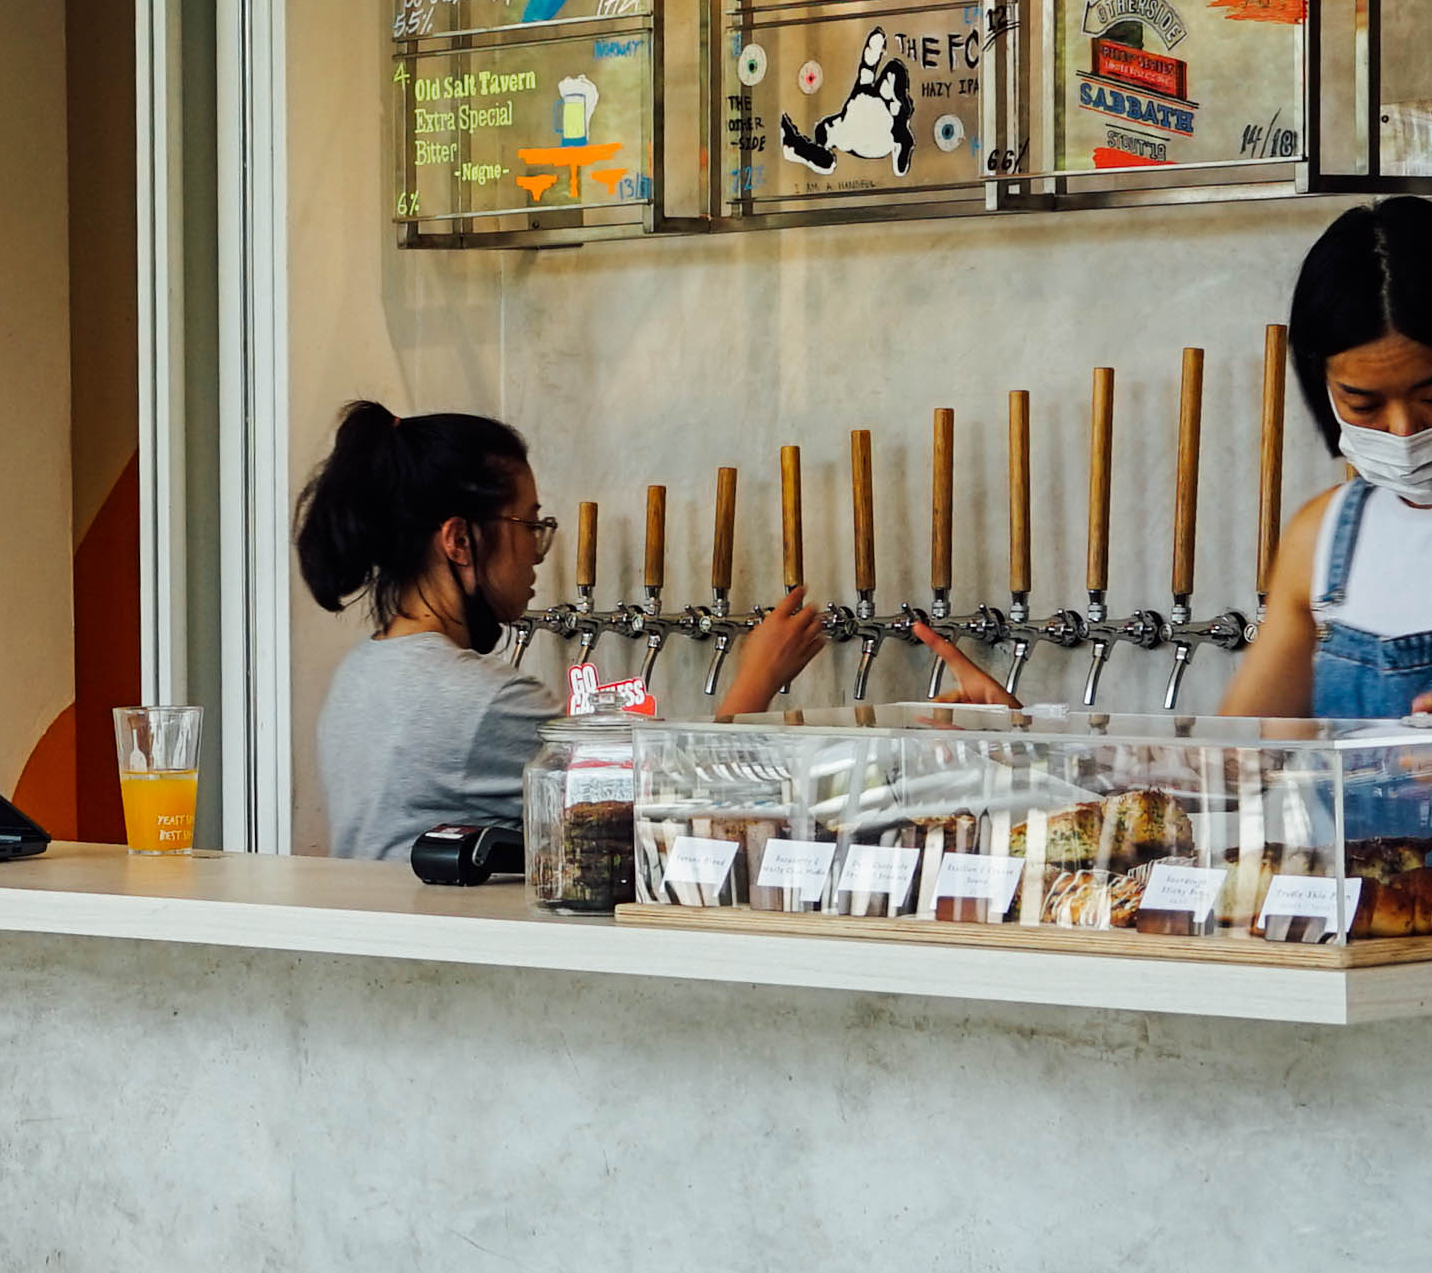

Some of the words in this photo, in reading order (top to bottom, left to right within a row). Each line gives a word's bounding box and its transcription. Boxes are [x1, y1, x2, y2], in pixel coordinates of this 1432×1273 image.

[415, 77, 440, 102] Old
[444, 74, 476, 99] Salt
[479, 71, 536, 96] Tavern
[414, 108, 456, 134] Extra
[458, 101, 513, 134] Special
[1079, 82, 1195, 134] SABBATH
[414, 140, 457, 166] Bitter
